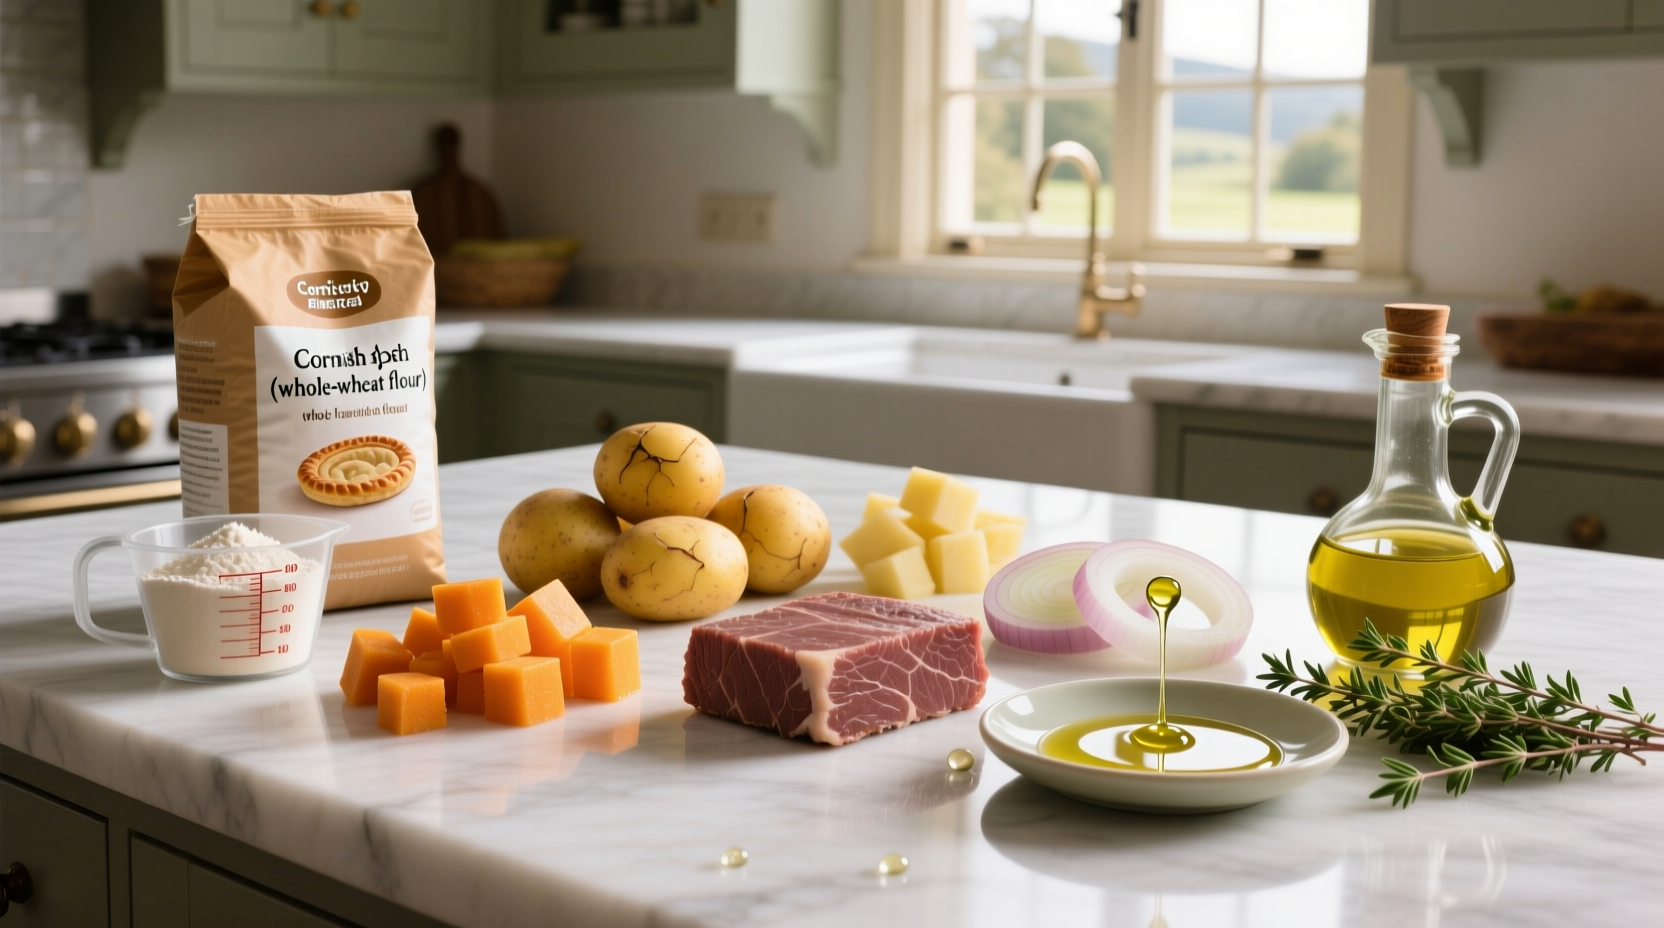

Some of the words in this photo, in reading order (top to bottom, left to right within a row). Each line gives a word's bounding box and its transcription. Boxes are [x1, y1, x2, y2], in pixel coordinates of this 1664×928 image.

[294, 346, 367, 369] Cornish
[270, 374, 385, 403] (whole-wheat
[388, 367, 427, 392] flour)
